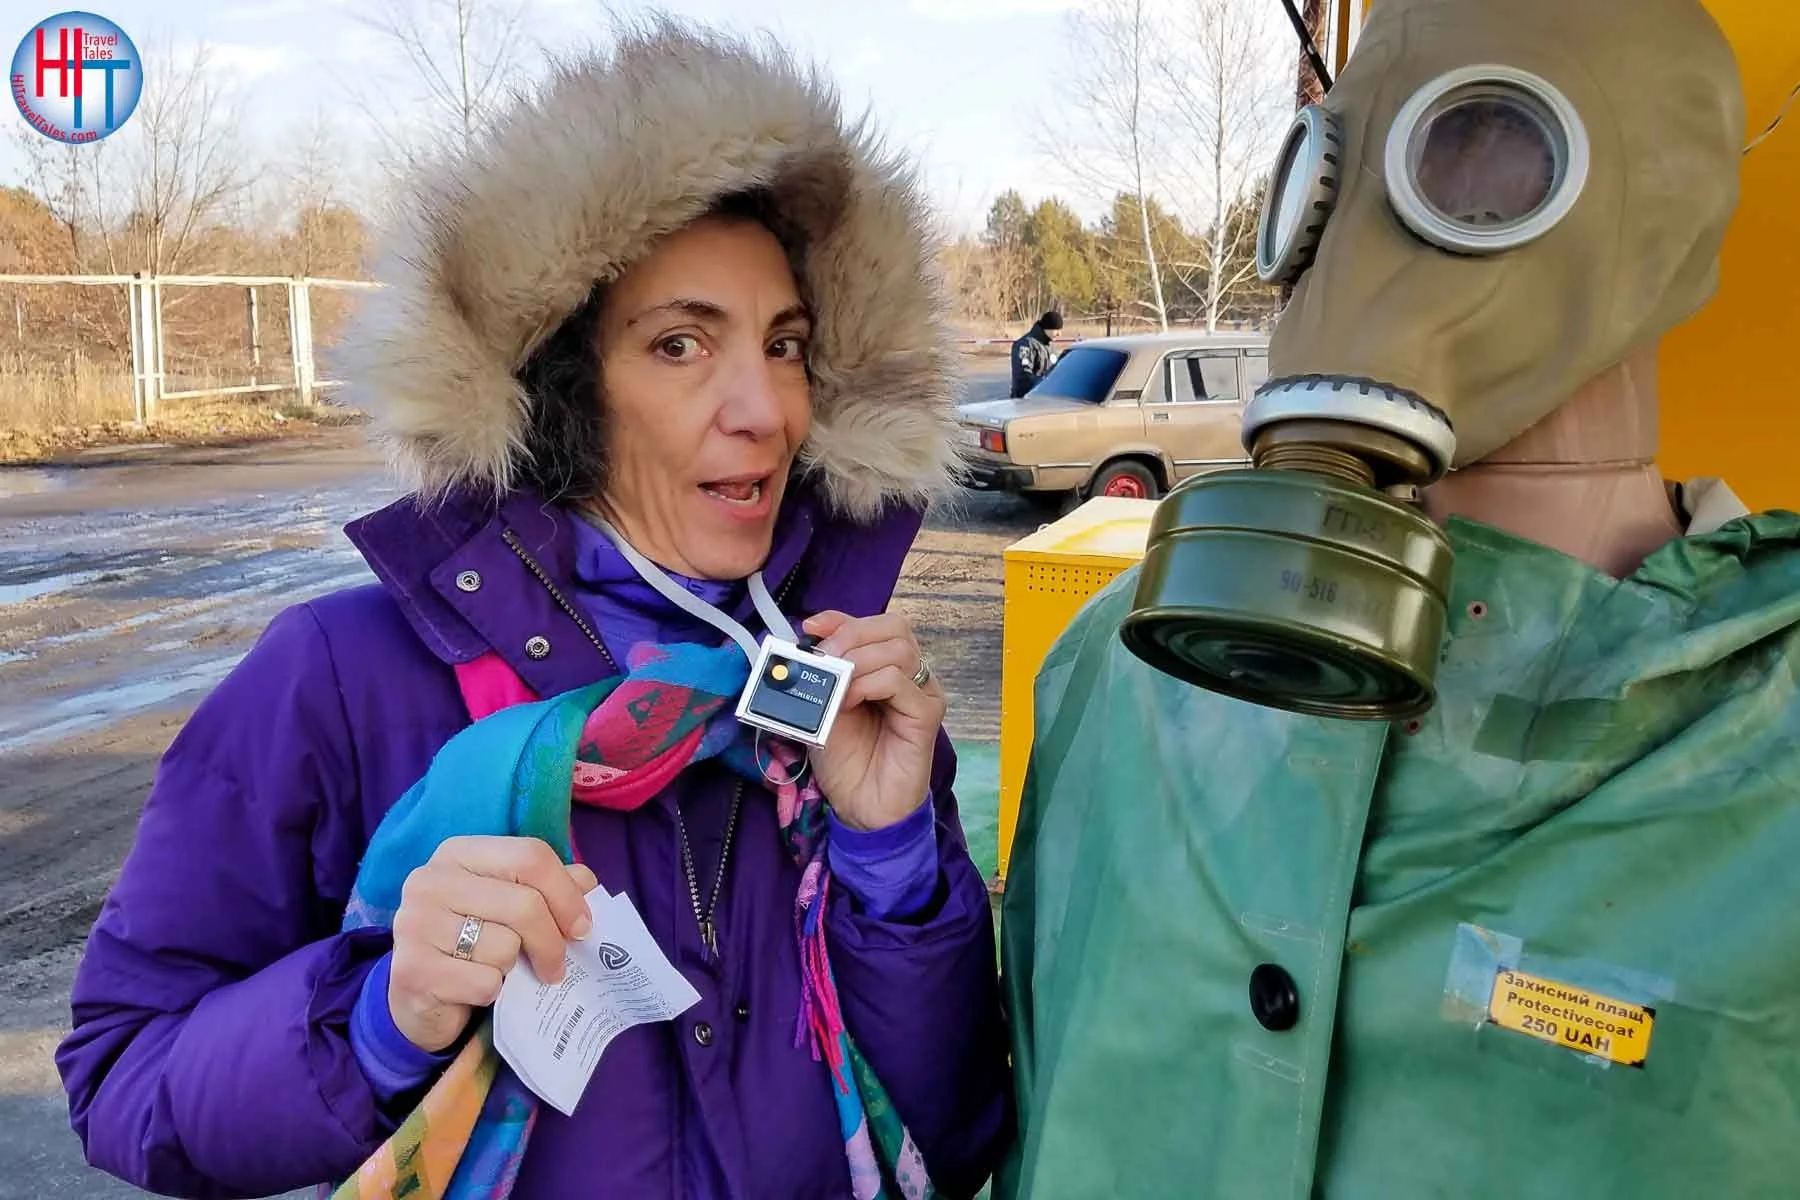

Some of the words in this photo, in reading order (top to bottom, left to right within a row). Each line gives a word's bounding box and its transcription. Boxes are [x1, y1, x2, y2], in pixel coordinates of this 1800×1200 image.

[800, 670, 827, 687] DIS-1
[1505, 972, 1590, 1006] Захисний
[1595, 1000, 1644, 1024] плащ
[1507, 991, 1634, 1039] Protectivecoat
[1522, 1014, 1557, 1037] 250
[1564, 1028, 1610, 1052] UAH
